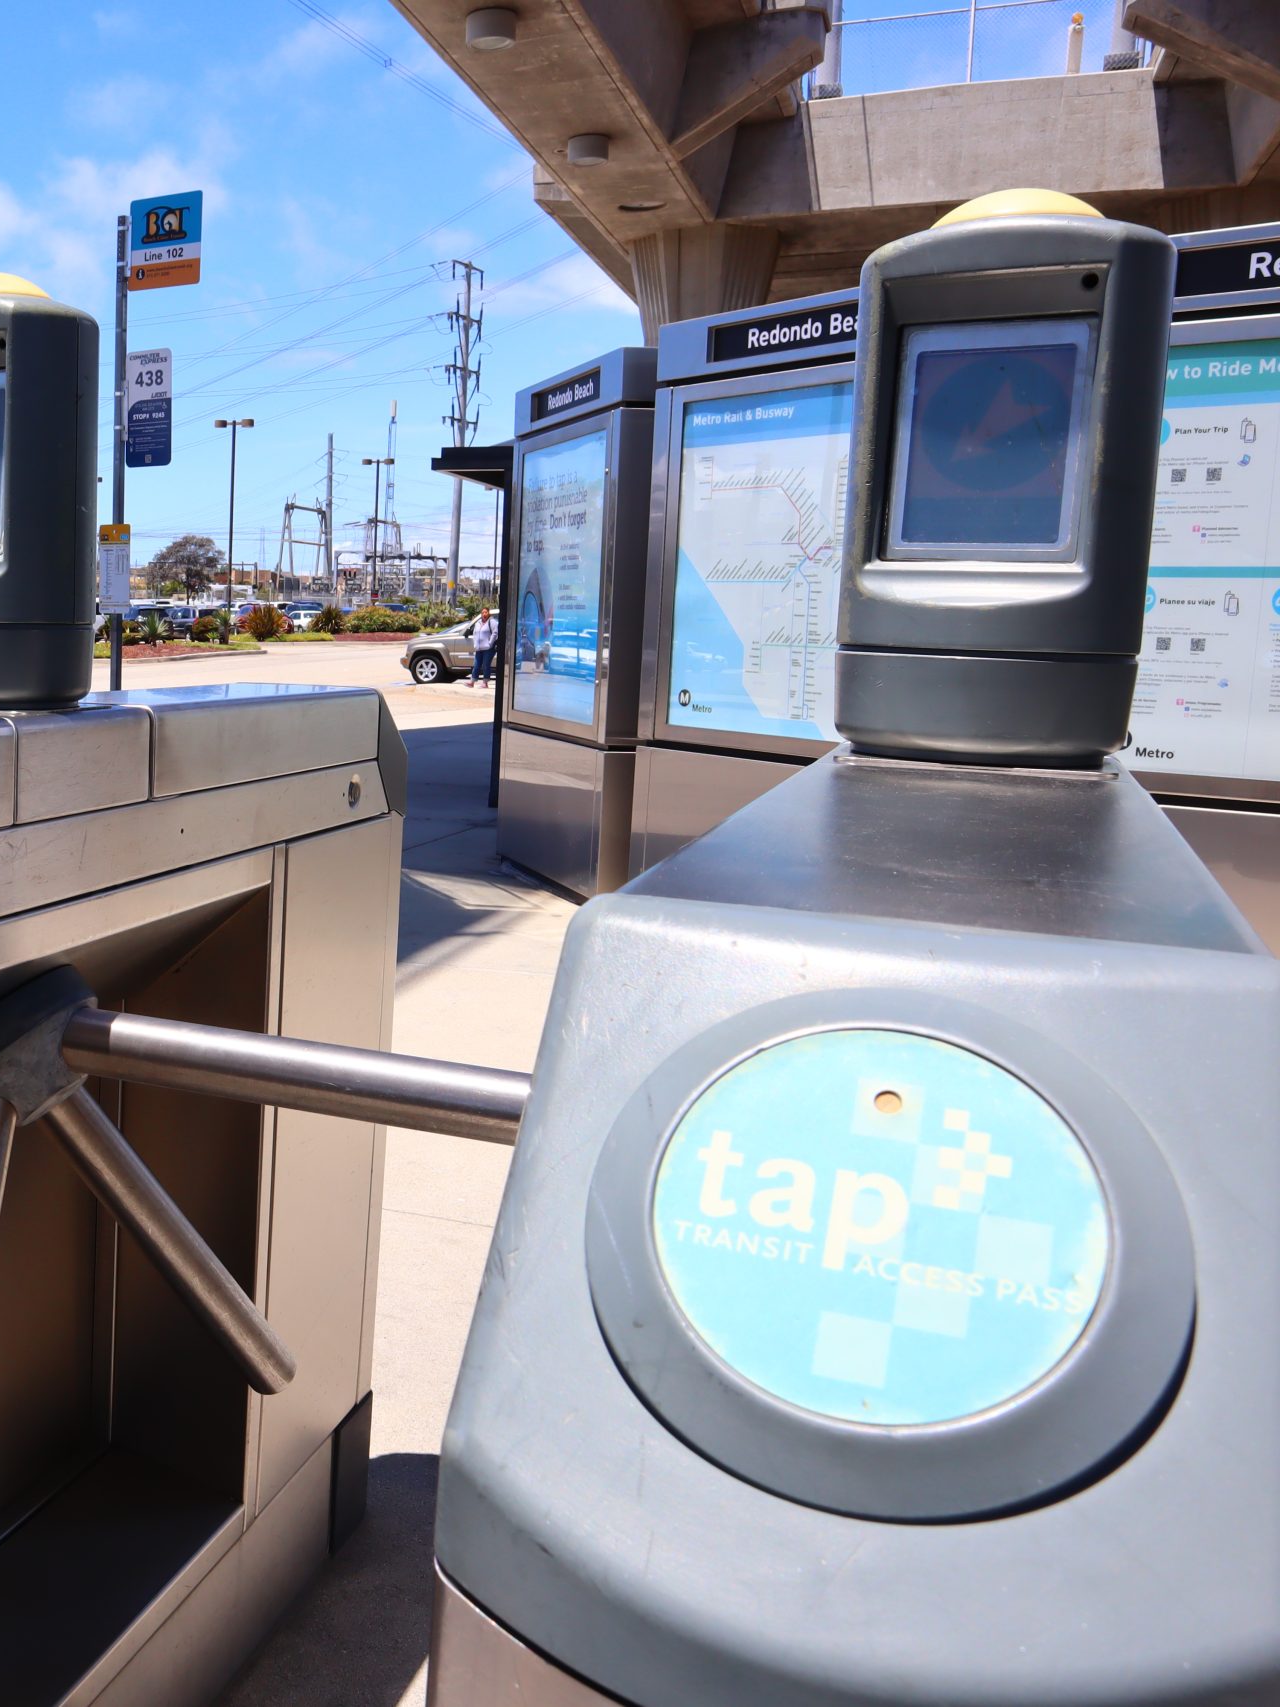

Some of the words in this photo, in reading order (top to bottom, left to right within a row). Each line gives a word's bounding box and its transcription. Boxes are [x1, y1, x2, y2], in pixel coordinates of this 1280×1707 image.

[144, 251, 163, 262] Line
[166, 247, 184, 259] 102
[747, 318, 822, 349] Redondo
[129, 352, 161, 361] COMMUTER
[140, 356, 168, 365] EXPRESS
[1184, 364, 1202, 379] to
[1208, 360, 1252, 378] Ride
[1259, 357, 1280, 374] M
[135, 369, 164, 388] 438
[547, 386, 573, 411] Redondo
[574, 378, 594, 401] Beach
[693, 414, 721, 426] Metro
[724, 411, 743, 423] Rail
[745, 409, 753, 421] &
[755, 406, 795, 420] Busway
[1213, 426, 1229, 434] Trip
[549, 511, 567, 530] Don't
[567, 508, 587, 530] forget
[526, 539, 533, 553] to
[533, 538, 545, 556] tap.
[1198, 598, 1216, 606] viaje
[692, 703, 713, 714] Metro
[1135, 746, 1175, 760] Metro
[697, 1129, 910, 1271] tap
[673, 1218, 816, 1265] TRANSIT
[852, 1254, 987, 1298] ACCESS
[995, 1277, 1087, 1316] PASS
